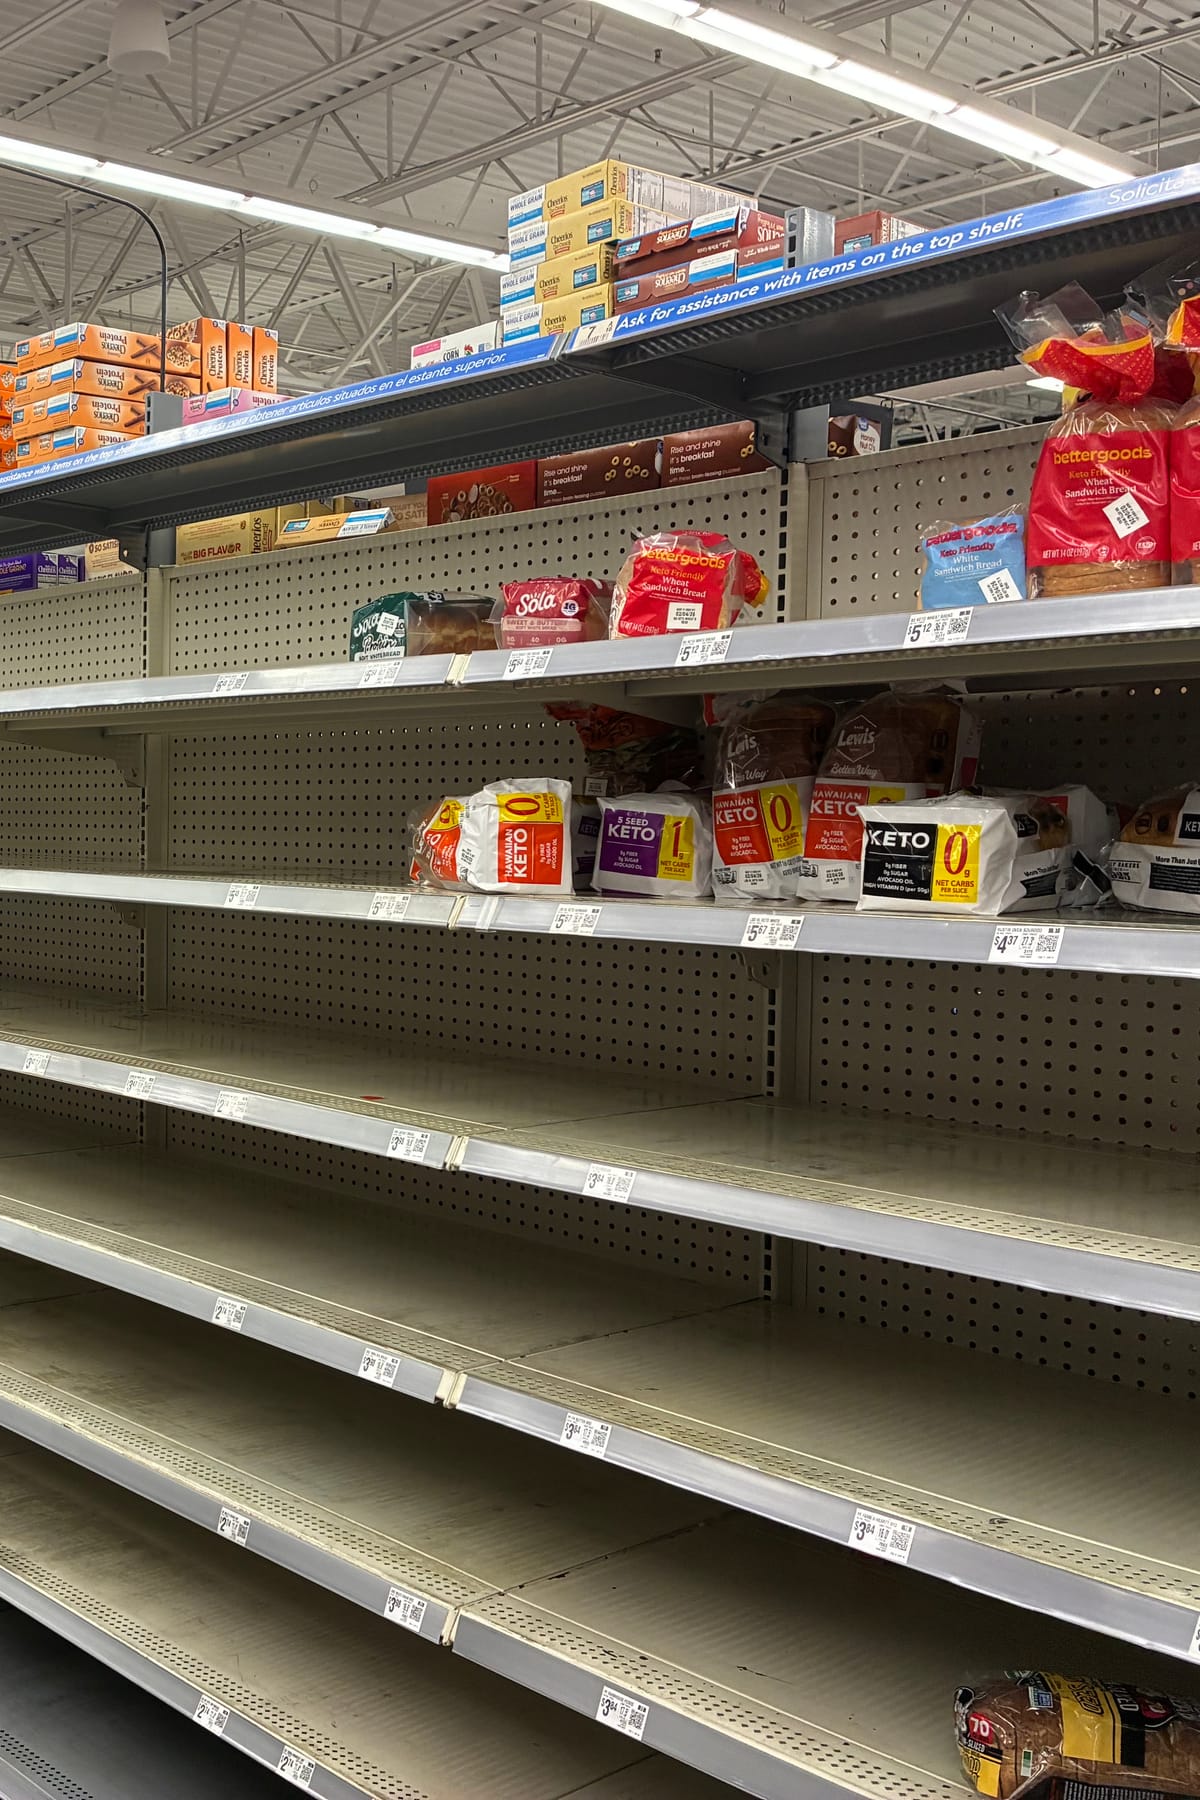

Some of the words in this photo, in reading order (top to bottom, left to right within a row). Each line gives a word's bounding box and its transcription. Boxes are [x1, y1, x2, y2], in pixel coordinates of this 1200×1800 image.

[1107, 178, 1185, 205] Solicita
[616, 310, 647, 330] Ask
[650, 301, 676, 323] for
[676, 283, 760, 315] assistance
[764, 271, 802, 292] with
[805, 261, 856, 283] items
[861, 252, 886, 267] on
[891, 241, 924, 262] the
[929, 230, 964, 255] top
[969, 212, 1024, 240] shelf.
[99, 331, 127, 345] Protein
[587, 326, 596, 339] 7
[96, 368, 125, 380] Protein
[249, 408, 290, 423] obtener
[334, 383, 376, 401] situados
[379, 380, 394, 391] en
[395, 374, 408, 387] el
[408, 365, 452, 384] estante
[453, 352, 507, 373] superior.
[92, 400, 121, 413] Protein
[860, 433, 876, 444] Honey
[670, 445, 684, 455] Rise
[685, 442, 701, 452] and
[701, 439, 721, 449] shine
[34, 464, 51, 474] with
[51, 460, 73, 472] items
[73, 456, 83, 466] on
[84, 453, 99, 464] the
[680, 450, 715, 463] breakfast
[1054, 446, 1152, 465] bettergoods
[544, 469, 556, 478] Rise
[557, 466, 569, 476] and
[570, 464, 588, 473] shine
[1069, 470, 1089, 479] Keto
[553, 474, 583, 485] breakfast
[1084, 478, 1113, 486] Wheat
[1065, 487, 1108, 498] Sandwich
[1109, 485, 1137, 495] Bread
[251, 517, 262, 554] heerios
[193, 548, 207, 559] BIG
[207, 543, 241, 557] FLAVOR
[940, 549, 957, 558] Keto
[959, 542, 995, 554] Friendly
[934, 563, 974, 576] Sandwich
[976, 558, 1002, 569] Bread
[953, 554, 980, 564] White
[651, 566, 670, 575] Keto
[670, 568, 706, 582] Friendly
[662, 576, 689, 587] Wheat
[642, 582, 681, 594] Sandwich
[683, 589, 706, 598] Bread
[515, 591, 556, 616] Sola
[838, 730, 876, 746] Lewis
[746, 769, 767, 781] Way
[831, 763, 856, 776] Better
[812, 790, 862, 800] HAWAIIAN
[505, 797, 541, 816] 0
[770, 795, 792, 832] 0
[810, 801, 860, 816] KETO
[625, 818, 648, 826] SEED
[716, 806, 757, 825] KETO
[608, 824, 655, 841] KETO
[1185, 821, 1200, 833] KET
[673, 821, 682, 857] 1
[868, 830, 930, 848] KETO
[504, 829, 513, 877] HAWAIIAN
[514, 828, 528, 878] KETO
[944, 831, 969, 875] 0
[1155, 855, 1170, 864] More
[1171, 857, 1186, 865] Than
[877, 876, 904, 884] AVOCADO
[951, 880, 975, 888] CARBS
[877, 883, 899, 891] VITAMIN
[905, 886, 916, 894] (per
[971, 1717, 990, 1737] 70
